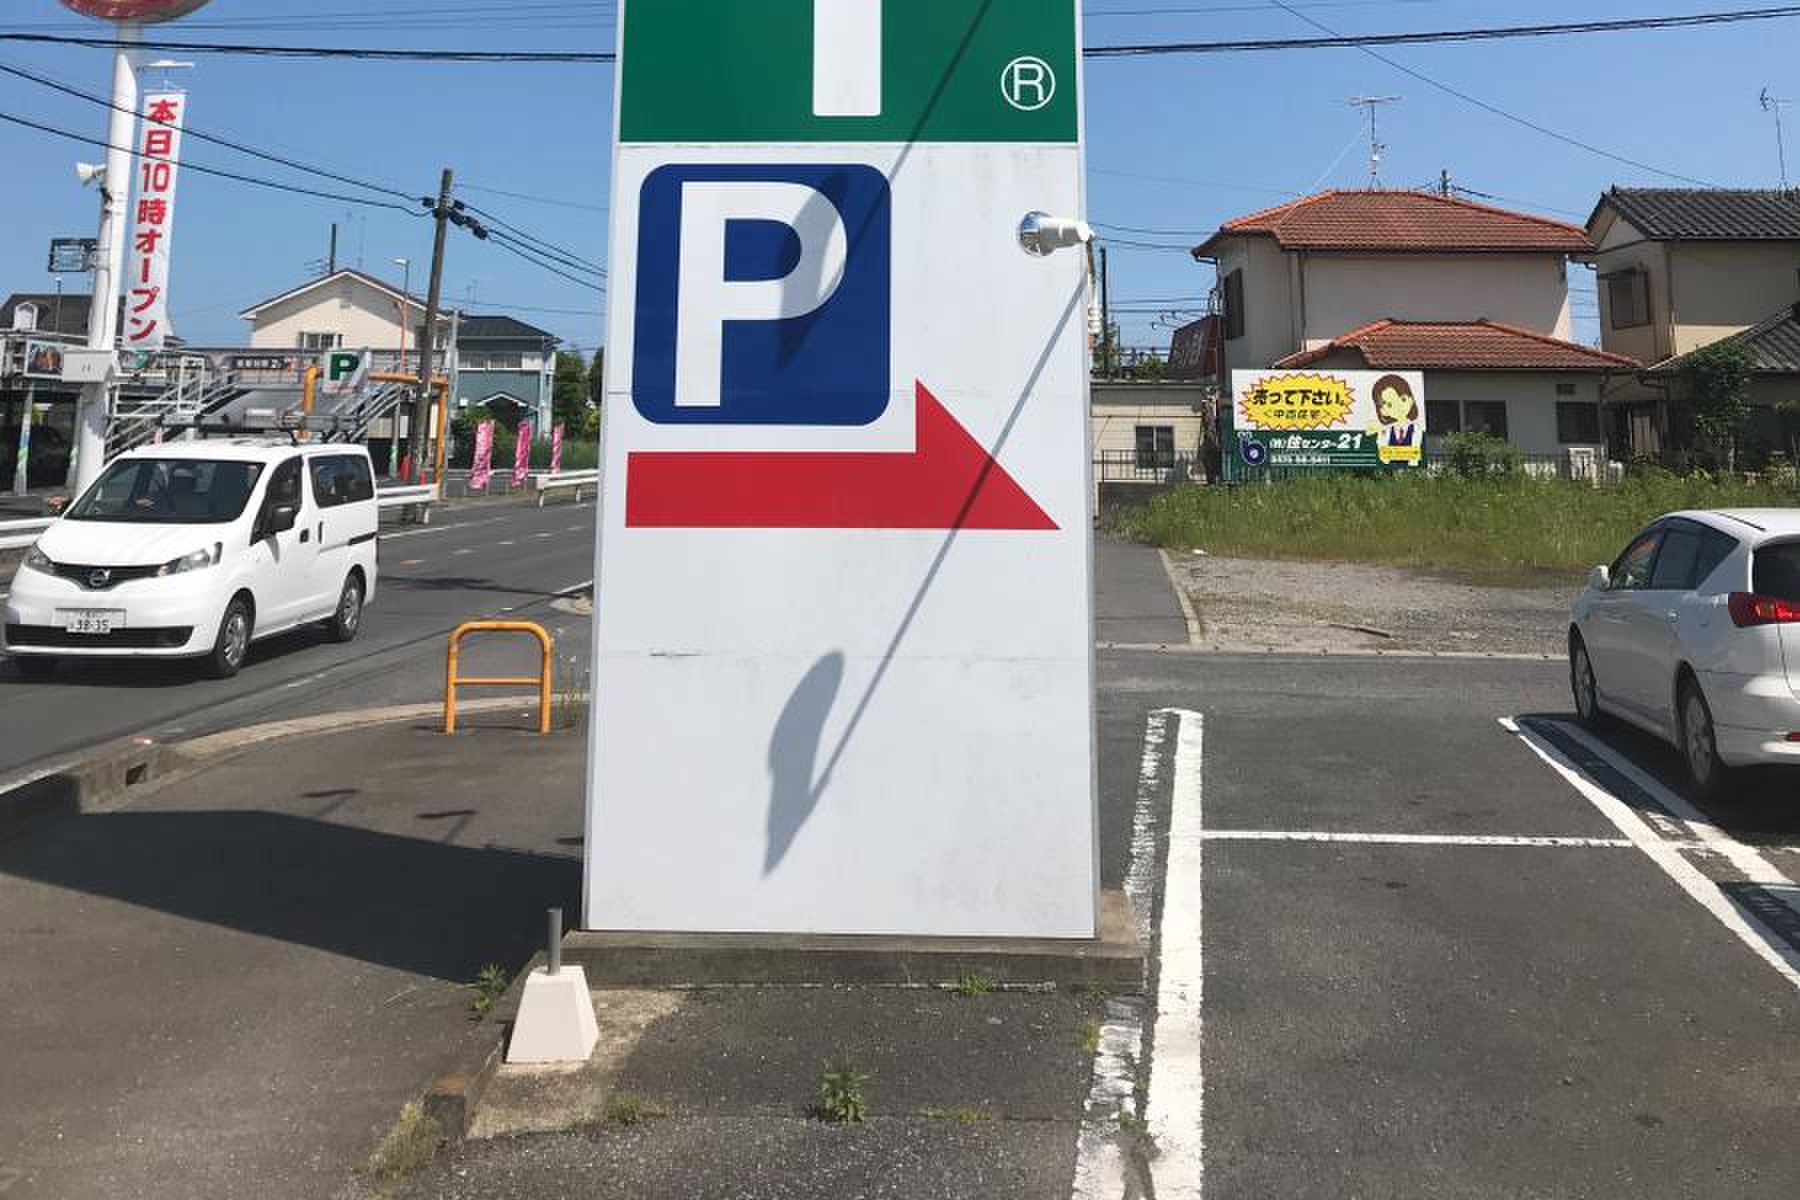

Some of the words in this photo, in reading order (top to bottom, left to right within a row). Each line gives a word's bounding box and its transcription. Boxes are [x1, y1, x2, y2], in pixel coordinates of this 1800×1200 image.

[128, 98, 179, 342] 本日10時オープン
[674, 180, 848, 408] P
[329, 353, 360, 381] P
